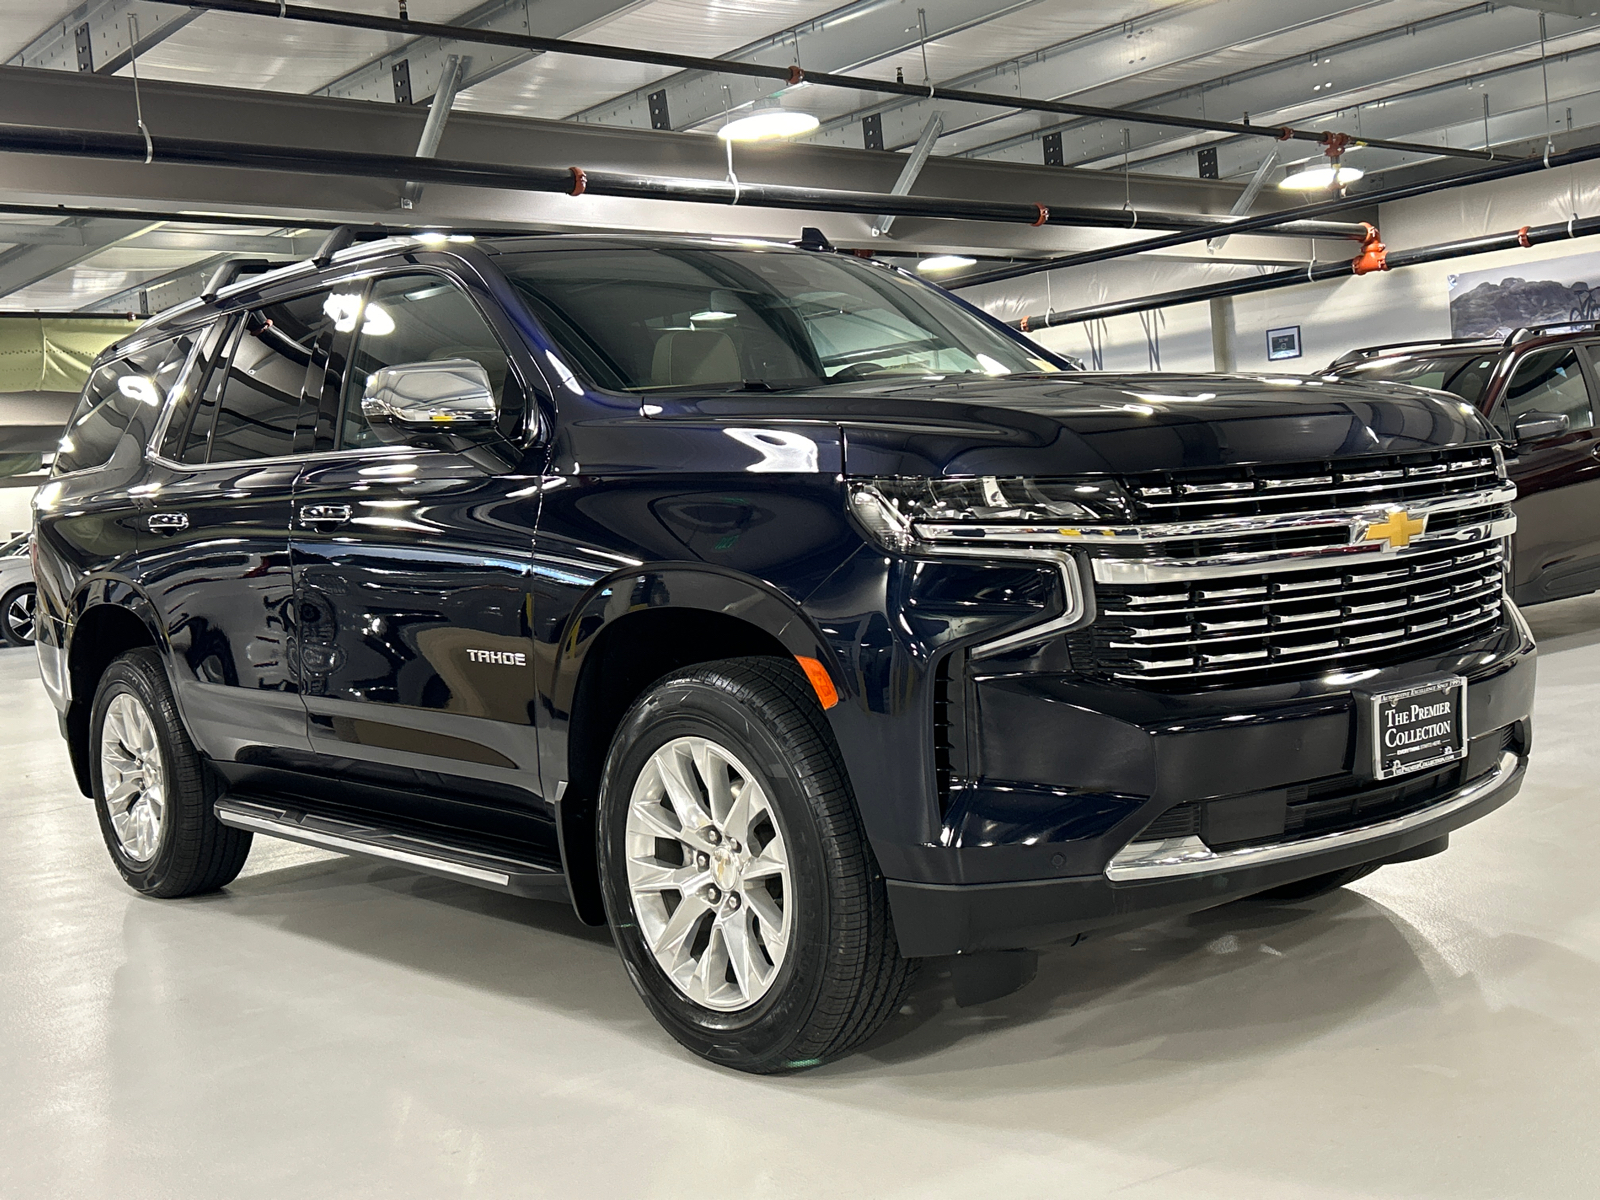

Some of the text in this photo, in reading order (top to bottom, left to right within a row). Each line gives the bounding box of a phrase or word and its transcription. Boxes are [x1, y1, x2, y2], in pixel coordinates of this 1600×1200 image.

[466, 648, 527, 667] TAHOE
[1385, 702, 1451, 727] THE PREMIER
[1385, 720, 1451, 747] COLLECTION
